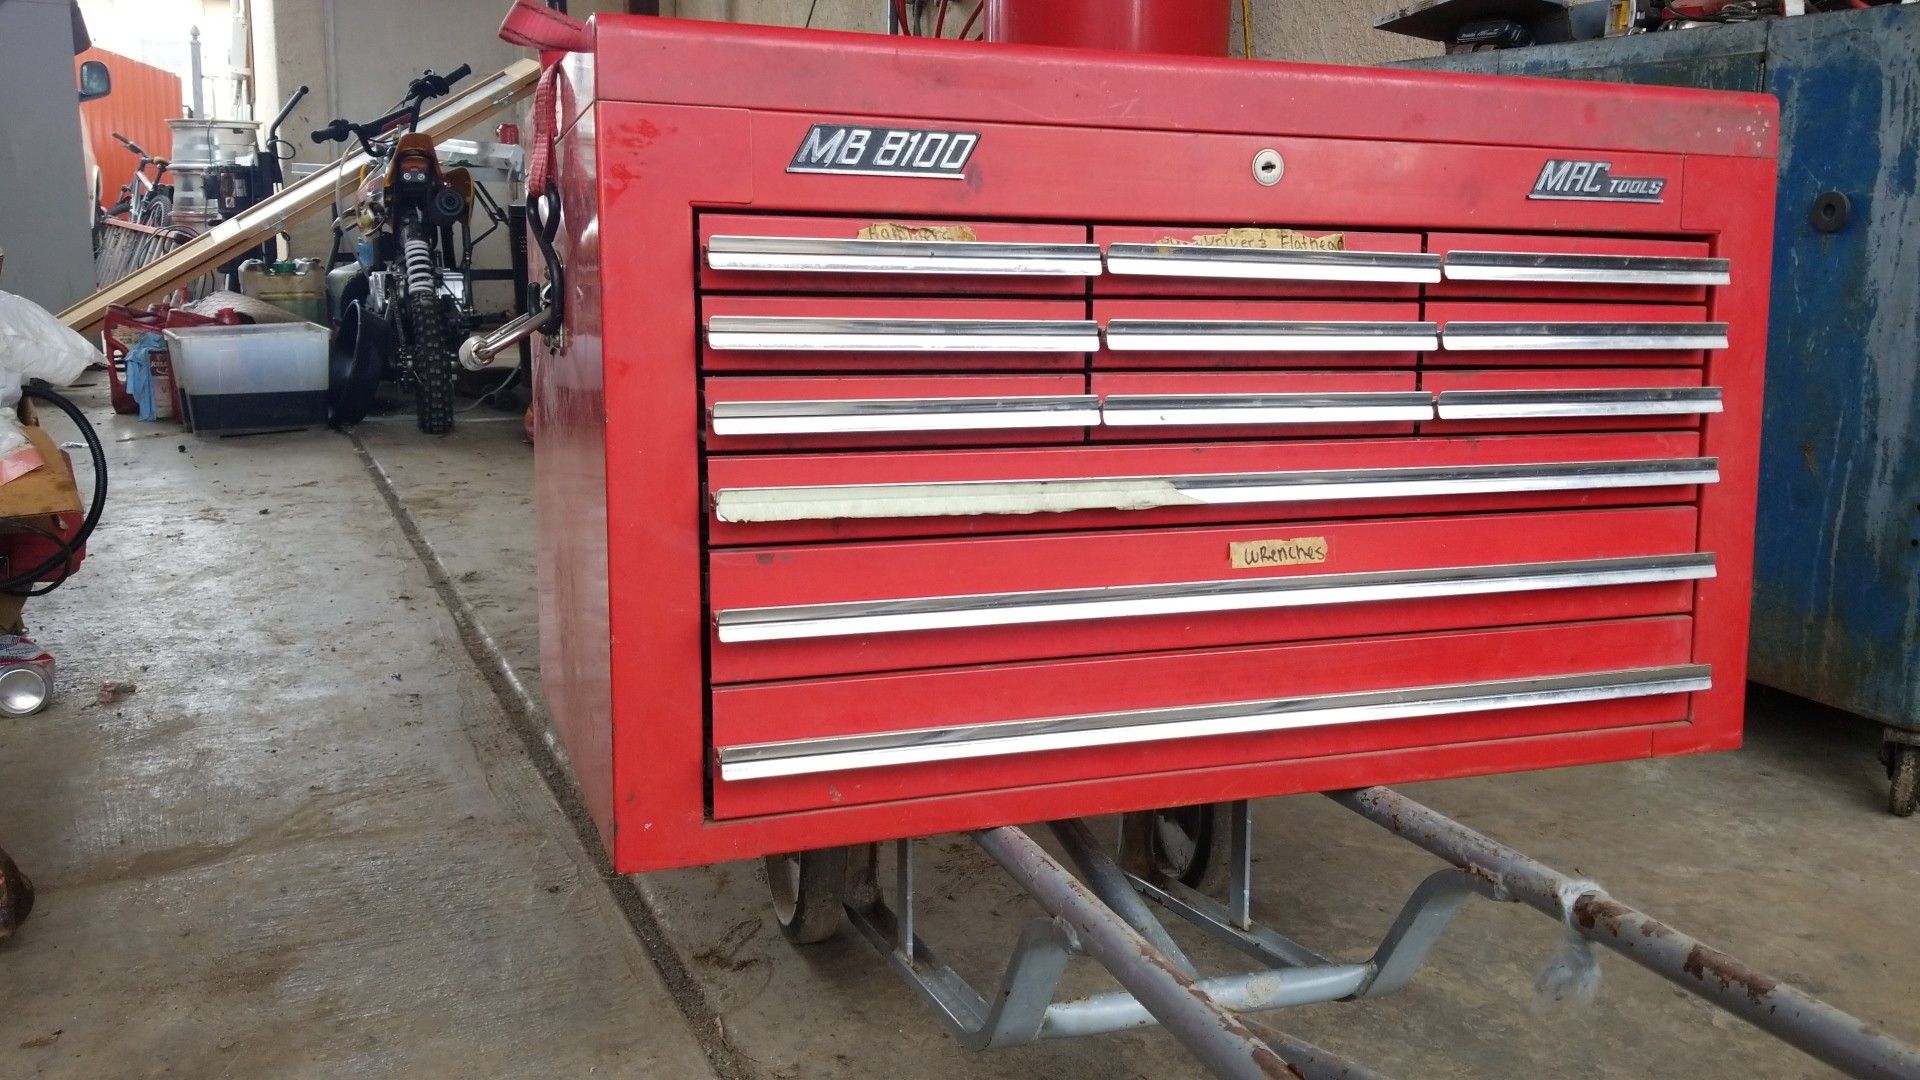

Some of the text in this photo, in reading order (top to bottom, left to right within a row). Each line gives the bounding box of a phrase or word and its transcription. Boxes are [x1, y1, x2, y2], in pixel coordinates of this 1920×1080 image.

[798, 127, 976, 169] MB 8100
[1536, 160, 1664, 195] MAC TOOLS
